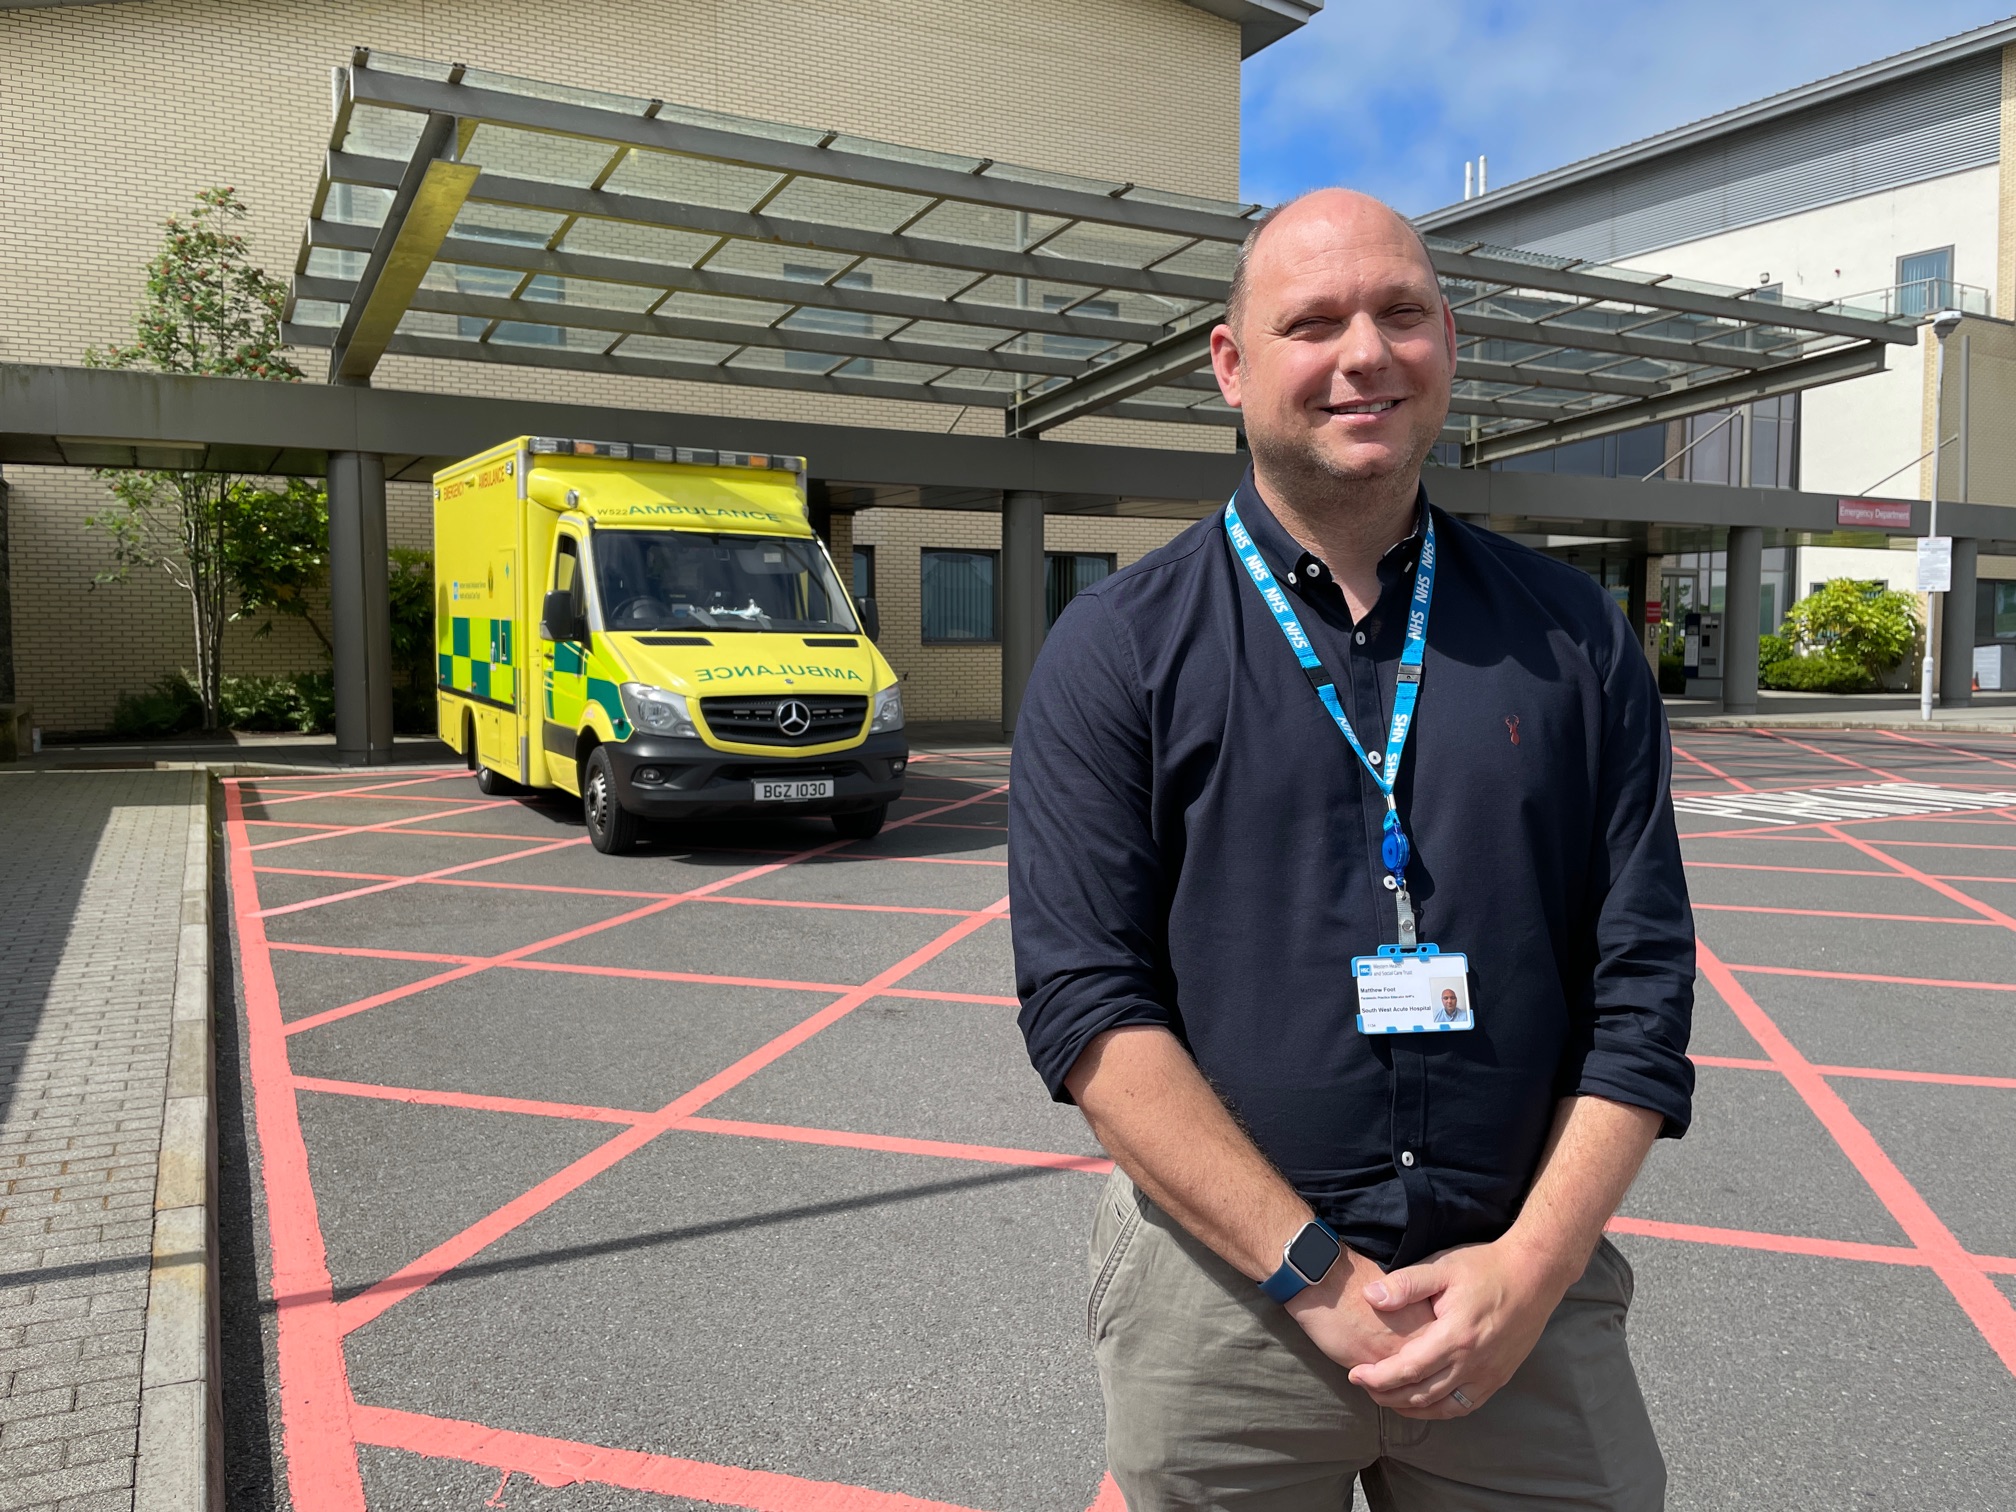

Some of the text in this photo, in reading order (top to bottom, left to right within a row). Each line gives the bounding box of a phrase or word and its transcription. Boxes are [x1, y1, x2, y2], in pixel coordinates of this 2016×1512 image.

[597, 508, 628, 516] W522
[629, 505, 782, 523] AMBULANCE
[1840, 505, 1910, 521] Emergency Department
[1230, 523, 1250, 549] NHS
[1245, 554, 1269, 582] NHS
[1422, 539, 1435, 569] NHS
[1264, 587, 1289, 614] NHS
[1415, 574, 1431, 604] NHS
[1283, 621, 1308, 649] NHS
[1408, 610, 1425, 640] NHS
[1337, 716, 1360, 746] NHS
[1391, 713, 1408, 743] NHS
[1385, 752, 1398, 785] NHS
[763, 782, 826, 799] BGZ 1030
